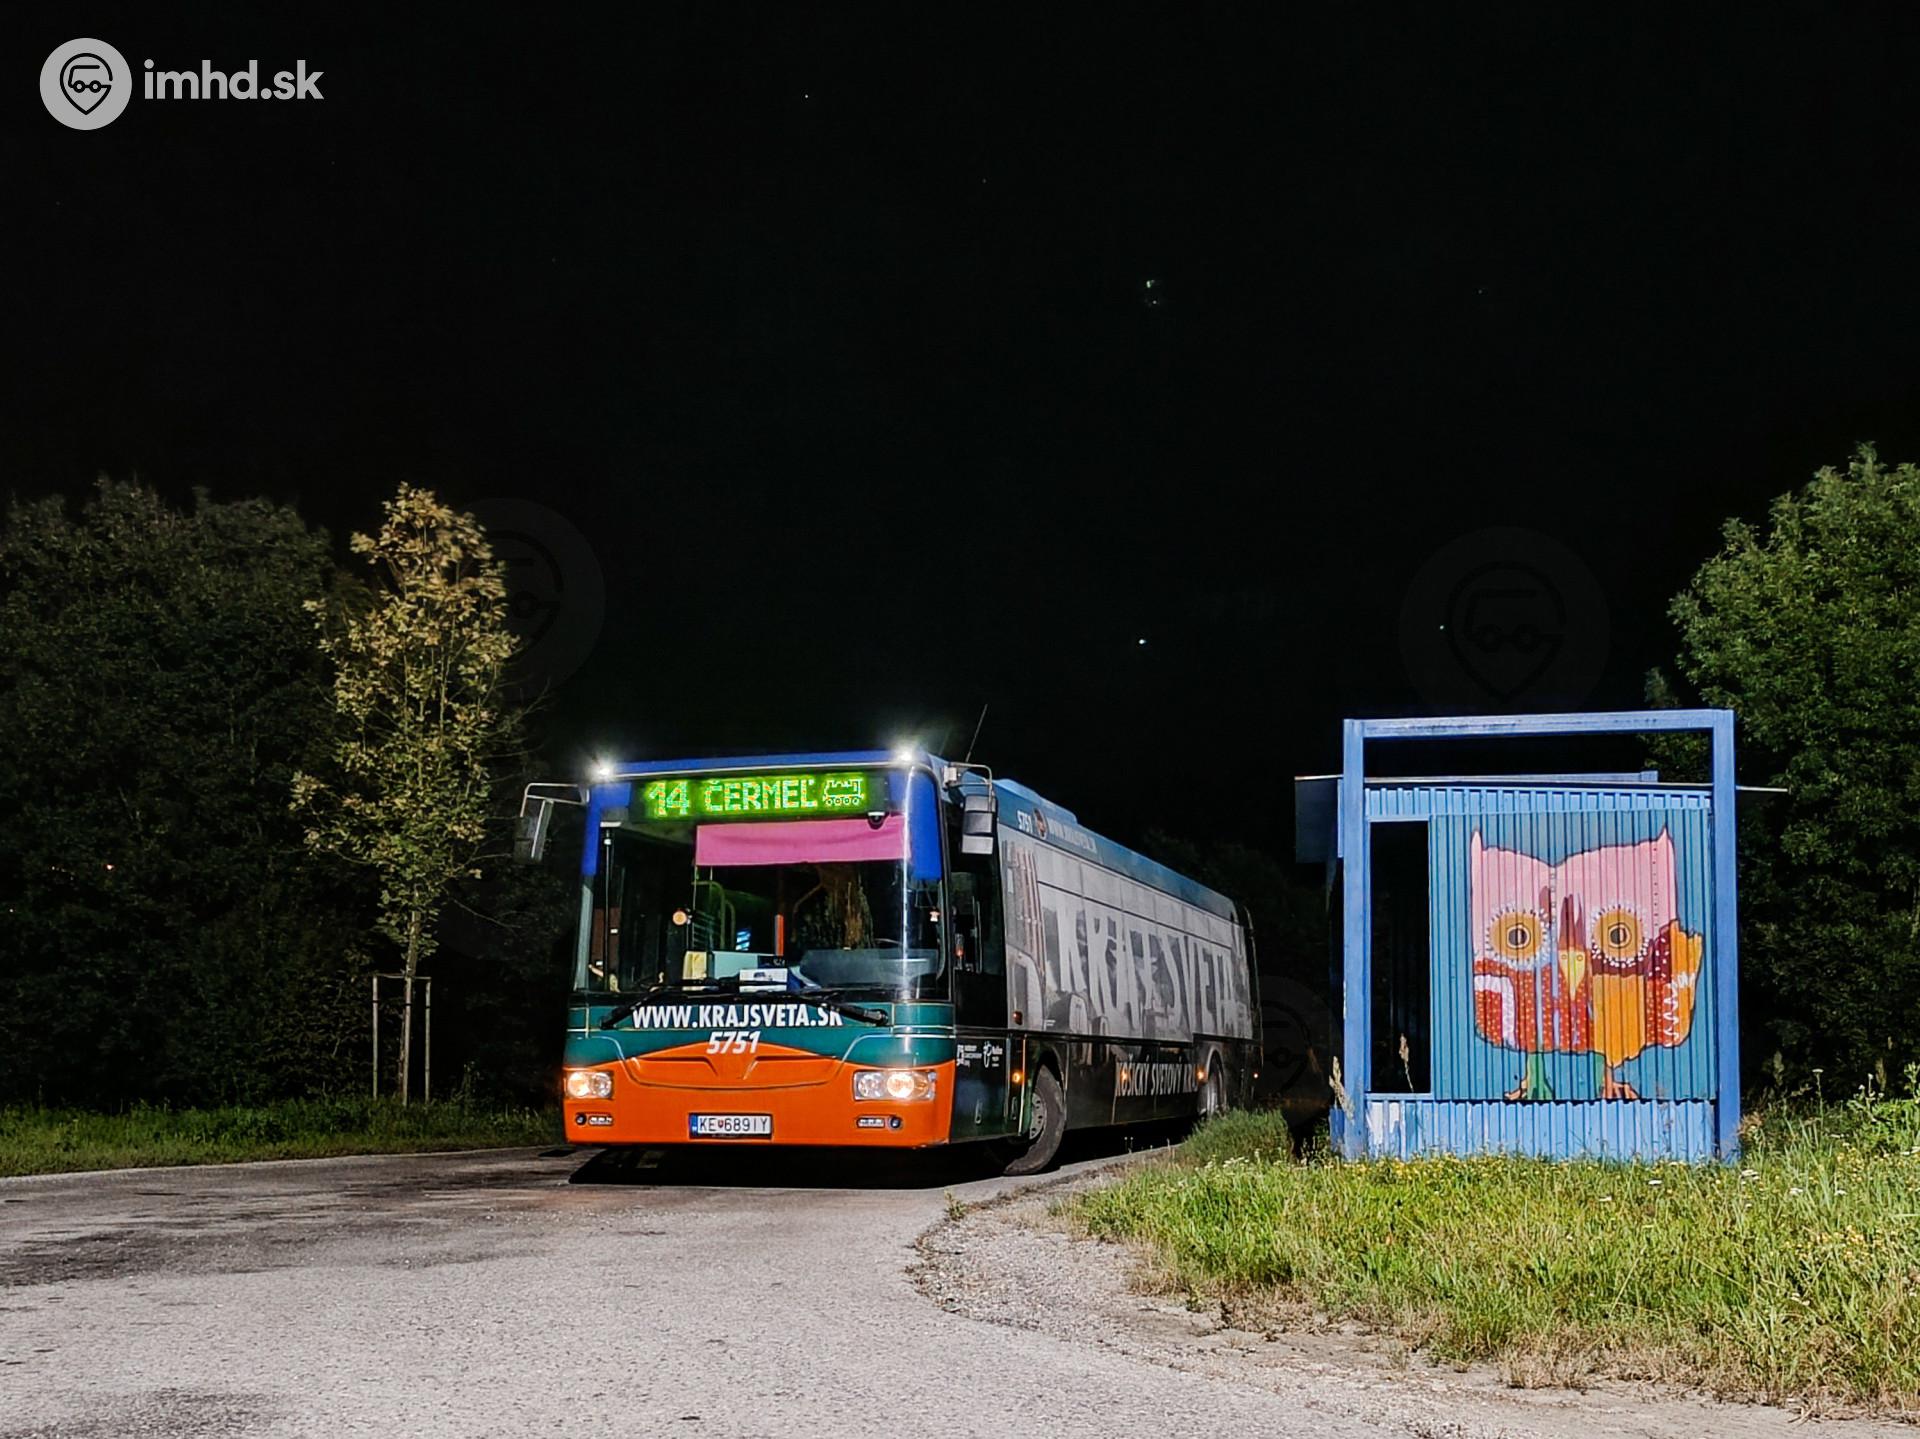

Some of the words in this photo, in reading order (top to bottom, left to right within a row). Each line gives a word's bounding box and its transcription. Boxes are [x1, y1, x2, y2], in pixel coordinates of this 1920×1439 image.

[650, 780, 689, 815] 14
[633, 1004, 843, 1028] WWW.KRAJSVETA.SK
[706, 1031, 761, 1054] 5751
